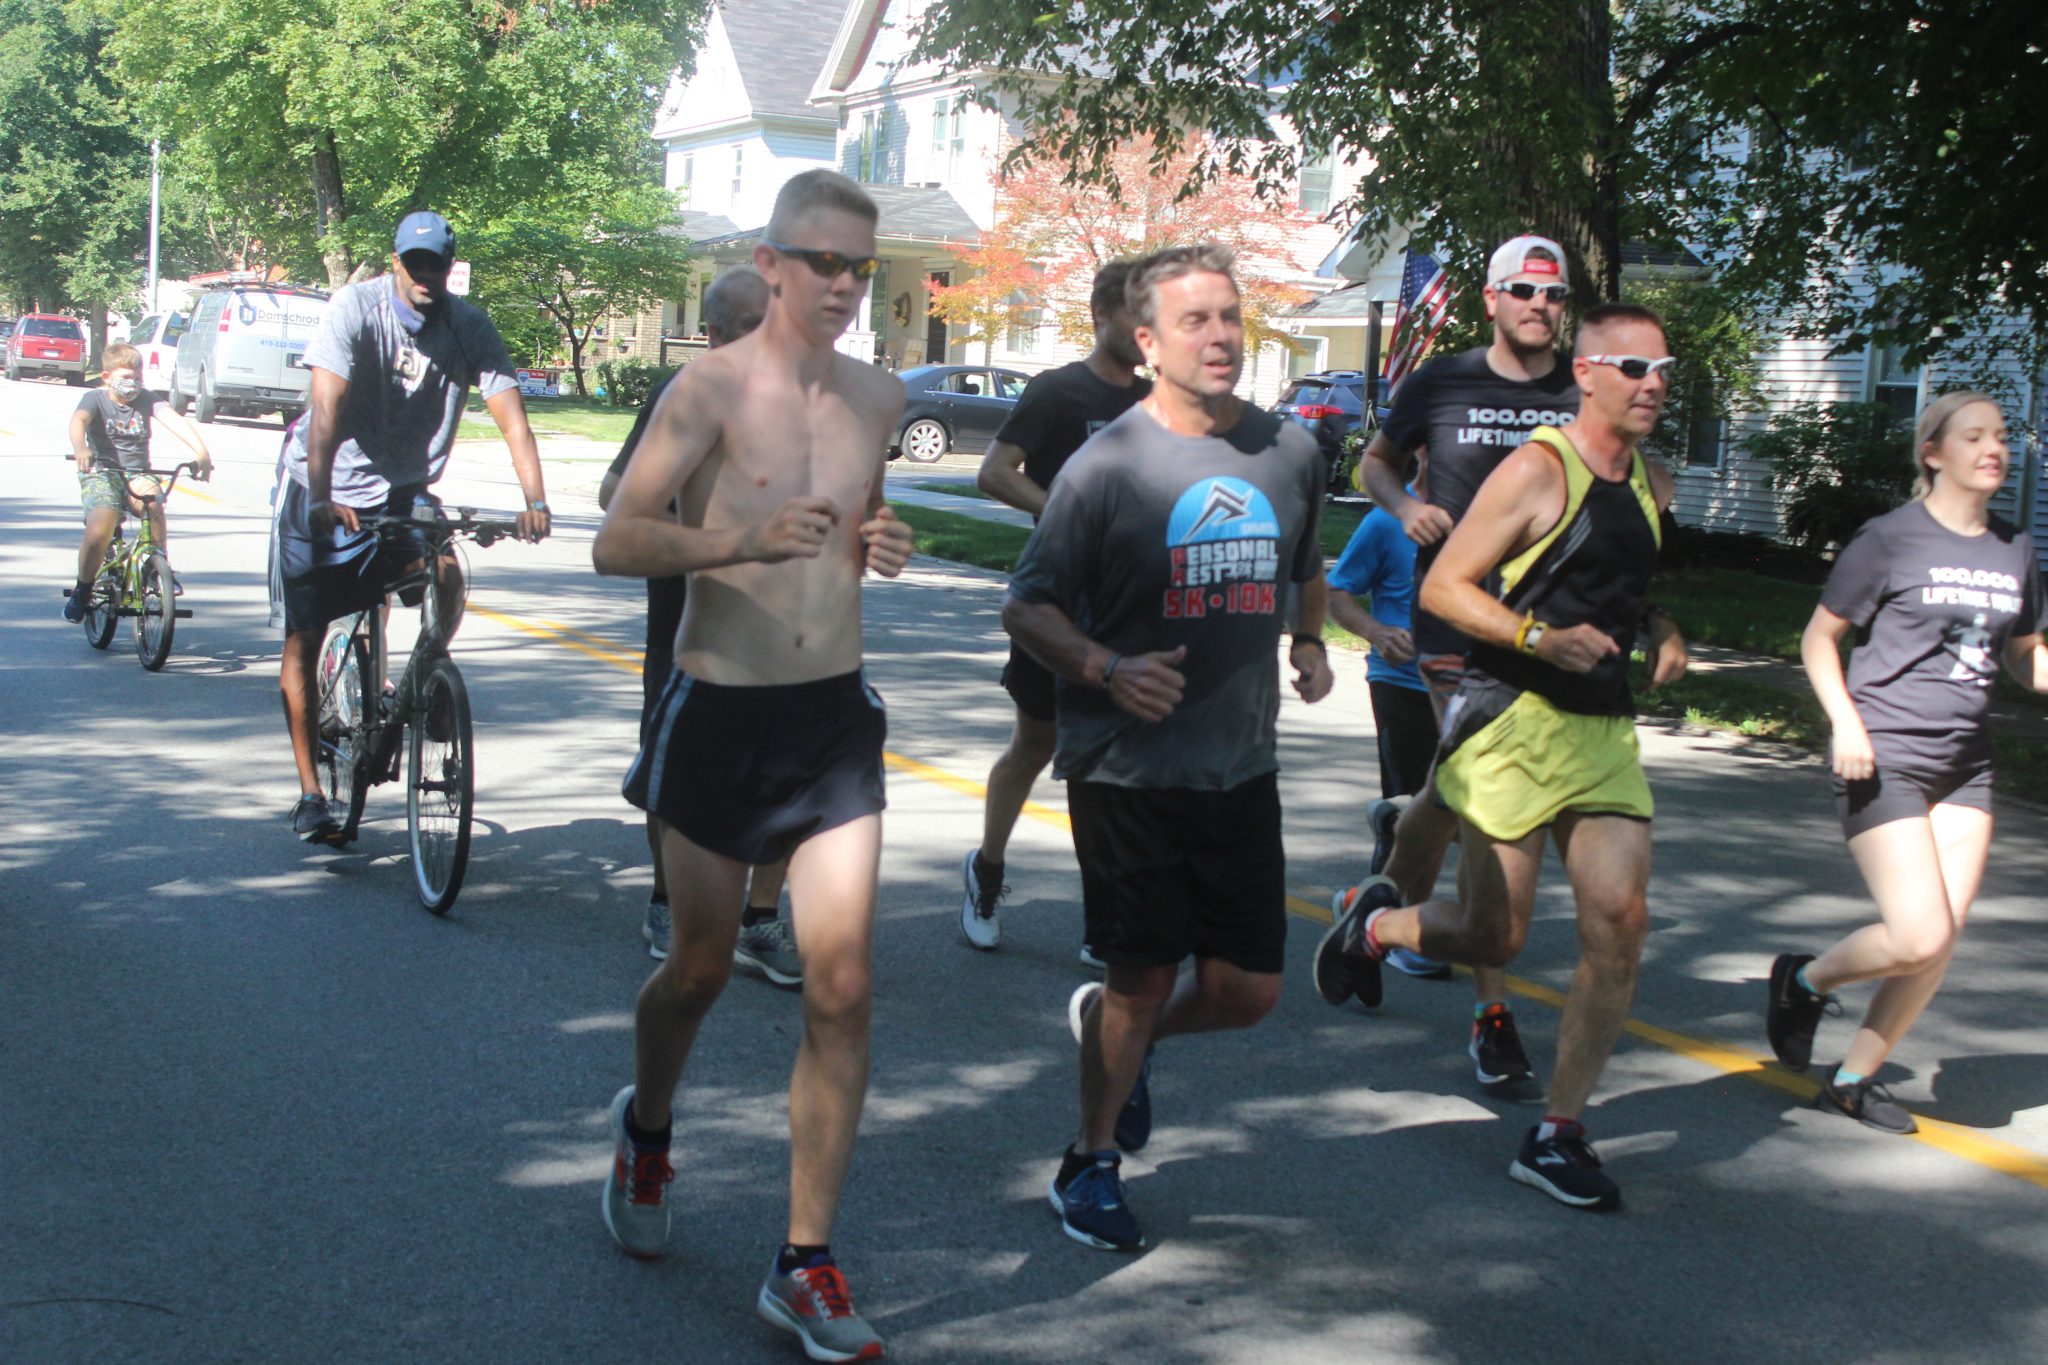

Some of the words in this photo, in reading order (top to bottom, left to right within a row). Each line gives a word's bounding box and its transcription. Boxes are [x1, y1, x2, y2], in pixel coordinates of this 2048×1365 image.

[1467, 407, 1577, 427] 100,000
[1171, 540, 1279, 566] PERSONAL
[1928, 567, 2018, 591] 100,000
[1163, 588, 1205, 617] 5K
[1227, 582, 1277, 614] 10K
